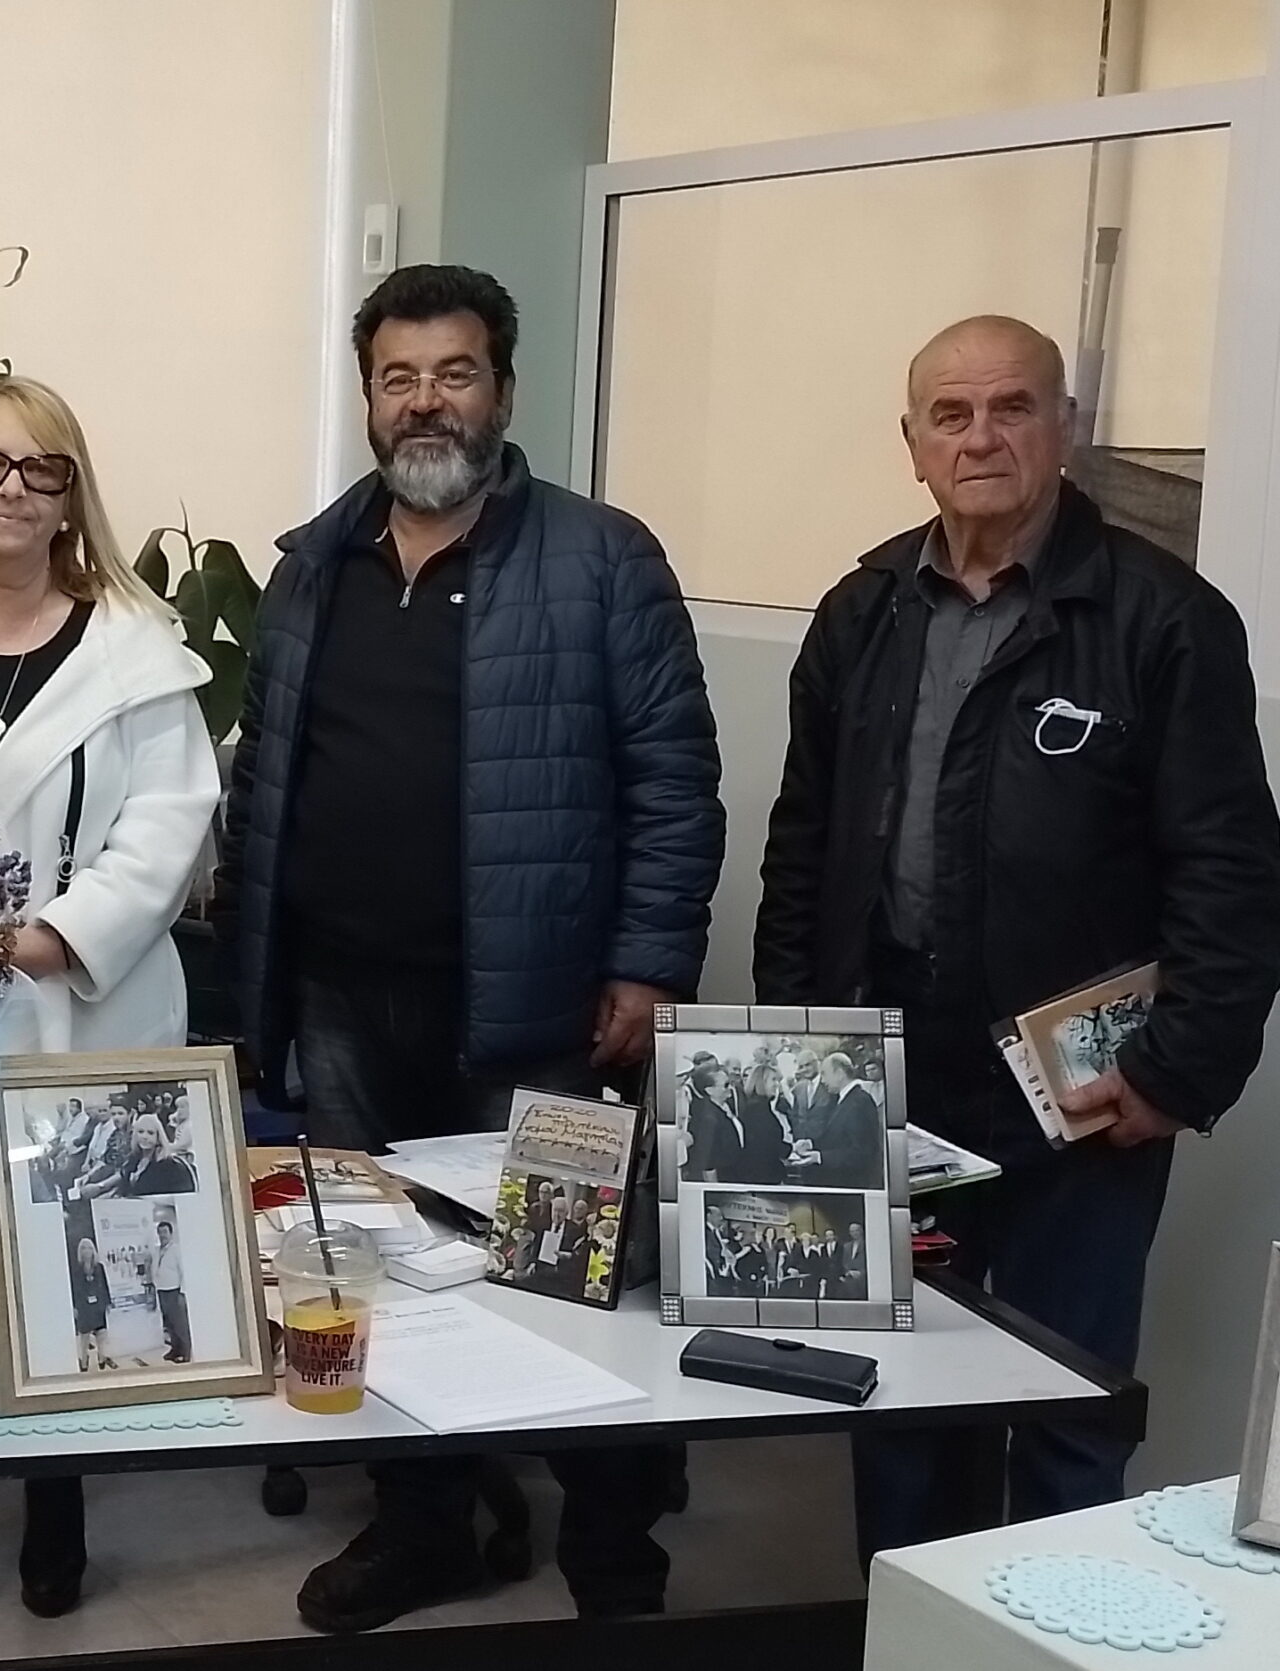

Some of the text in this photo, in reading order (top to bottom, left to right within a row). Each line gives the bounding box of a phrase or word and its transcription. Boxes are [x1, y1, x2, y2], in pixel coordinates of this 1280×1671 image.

[549, 1104, 597, 1117] 2020
[332, 1332, 355, 1346] DAY
[310, 1345, 317, 1358] A
[322, 1346, 350, 1360] NEW
[301, 1370, 344, 1387] LIVE IT.
